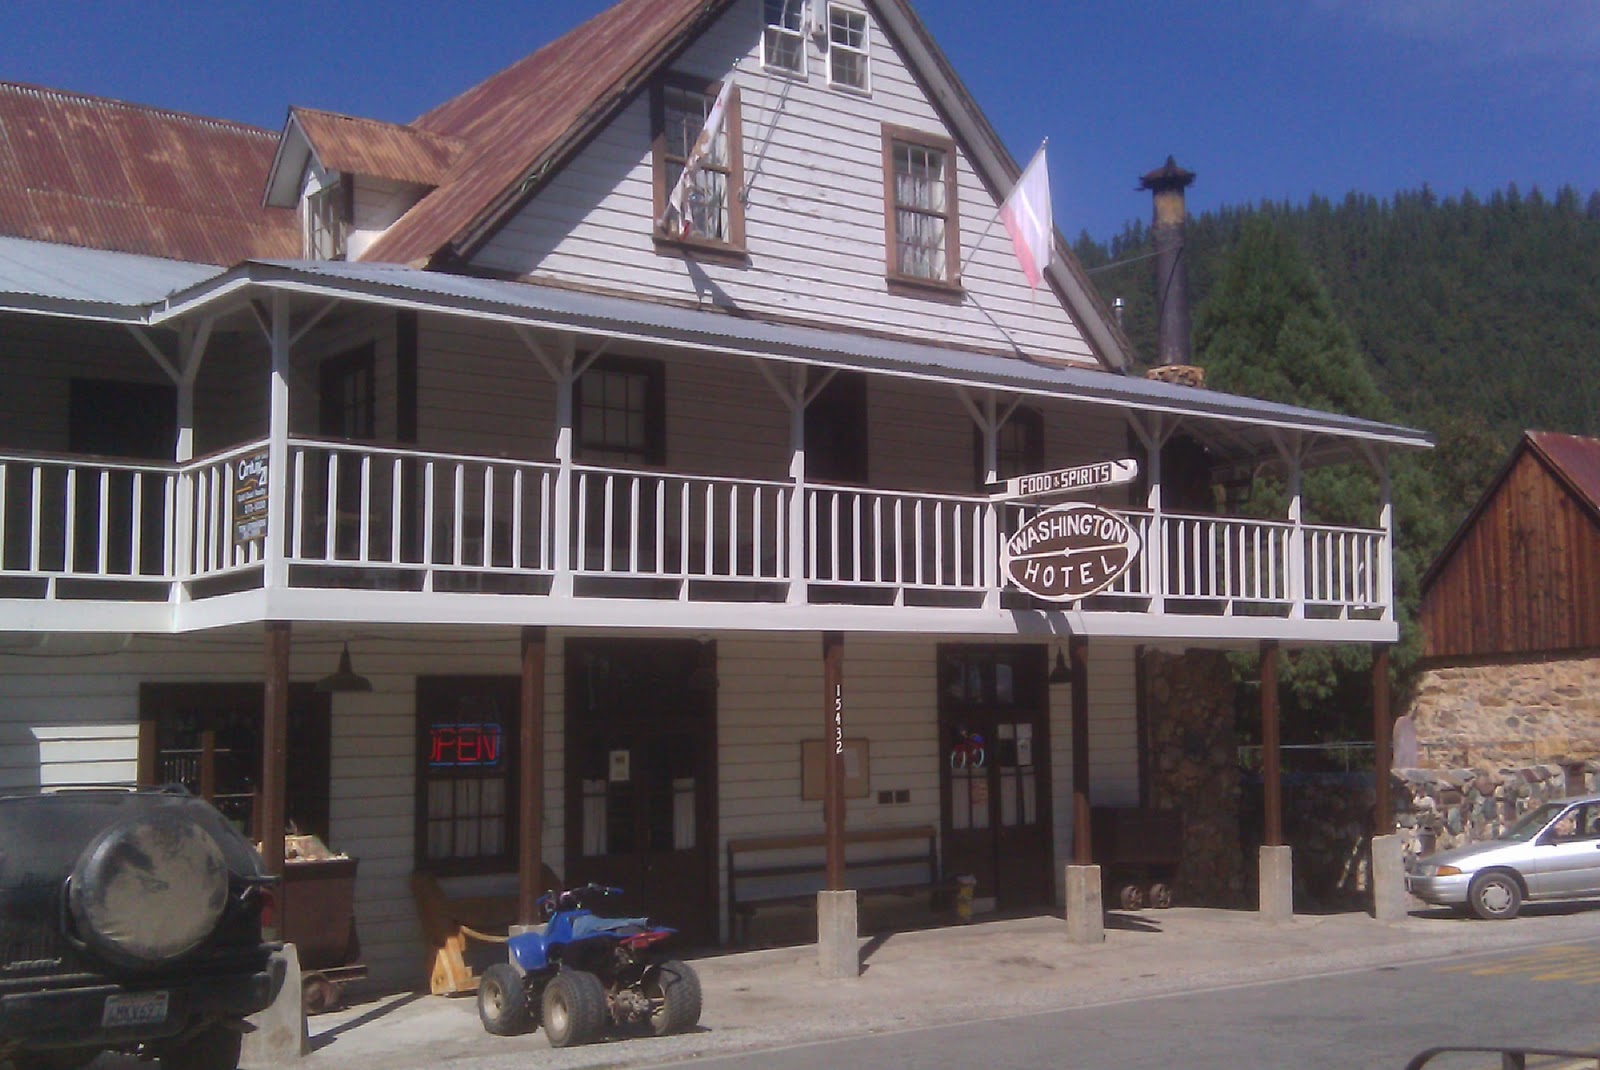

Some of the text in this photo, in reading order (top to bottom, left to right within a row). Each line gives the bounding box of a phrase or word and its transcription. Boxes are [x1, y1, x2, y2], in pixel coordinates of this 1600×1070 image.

[1020, 474, 1051, 495] FOOD
[1060, 464, 1110, 488] SPIRITS
[1011, 513, 1126, 555] WASHINGTON
[1024, 555, 1117, 588] HOTEL
[835, 684, 843, 755] 15432
